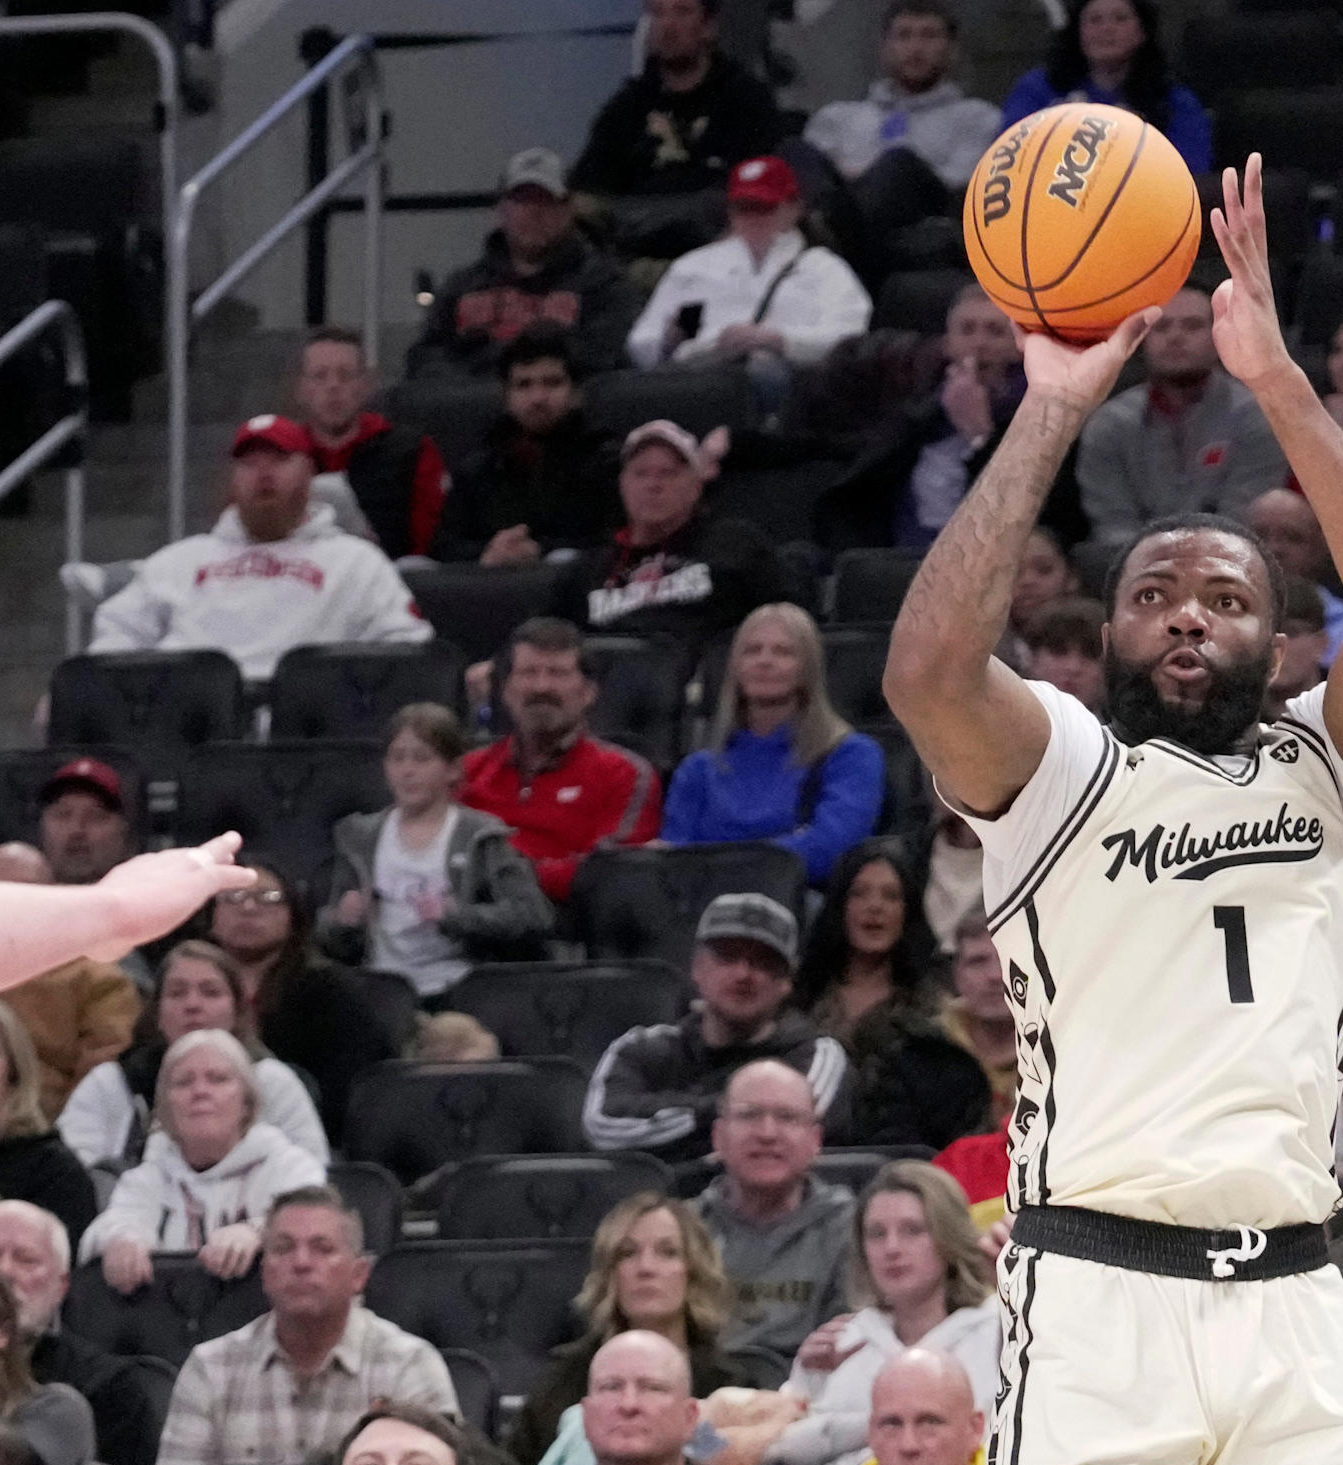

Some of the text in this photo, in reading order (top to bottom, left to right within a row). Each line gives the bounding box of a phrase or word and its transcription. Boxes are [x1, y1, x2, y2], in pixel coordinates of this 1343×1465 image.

[1047, 116, 1117, 209] NCAA
[1101, 802, 1324, 884] Milwaukee
[1213, 906, 1255, 1004] 1
